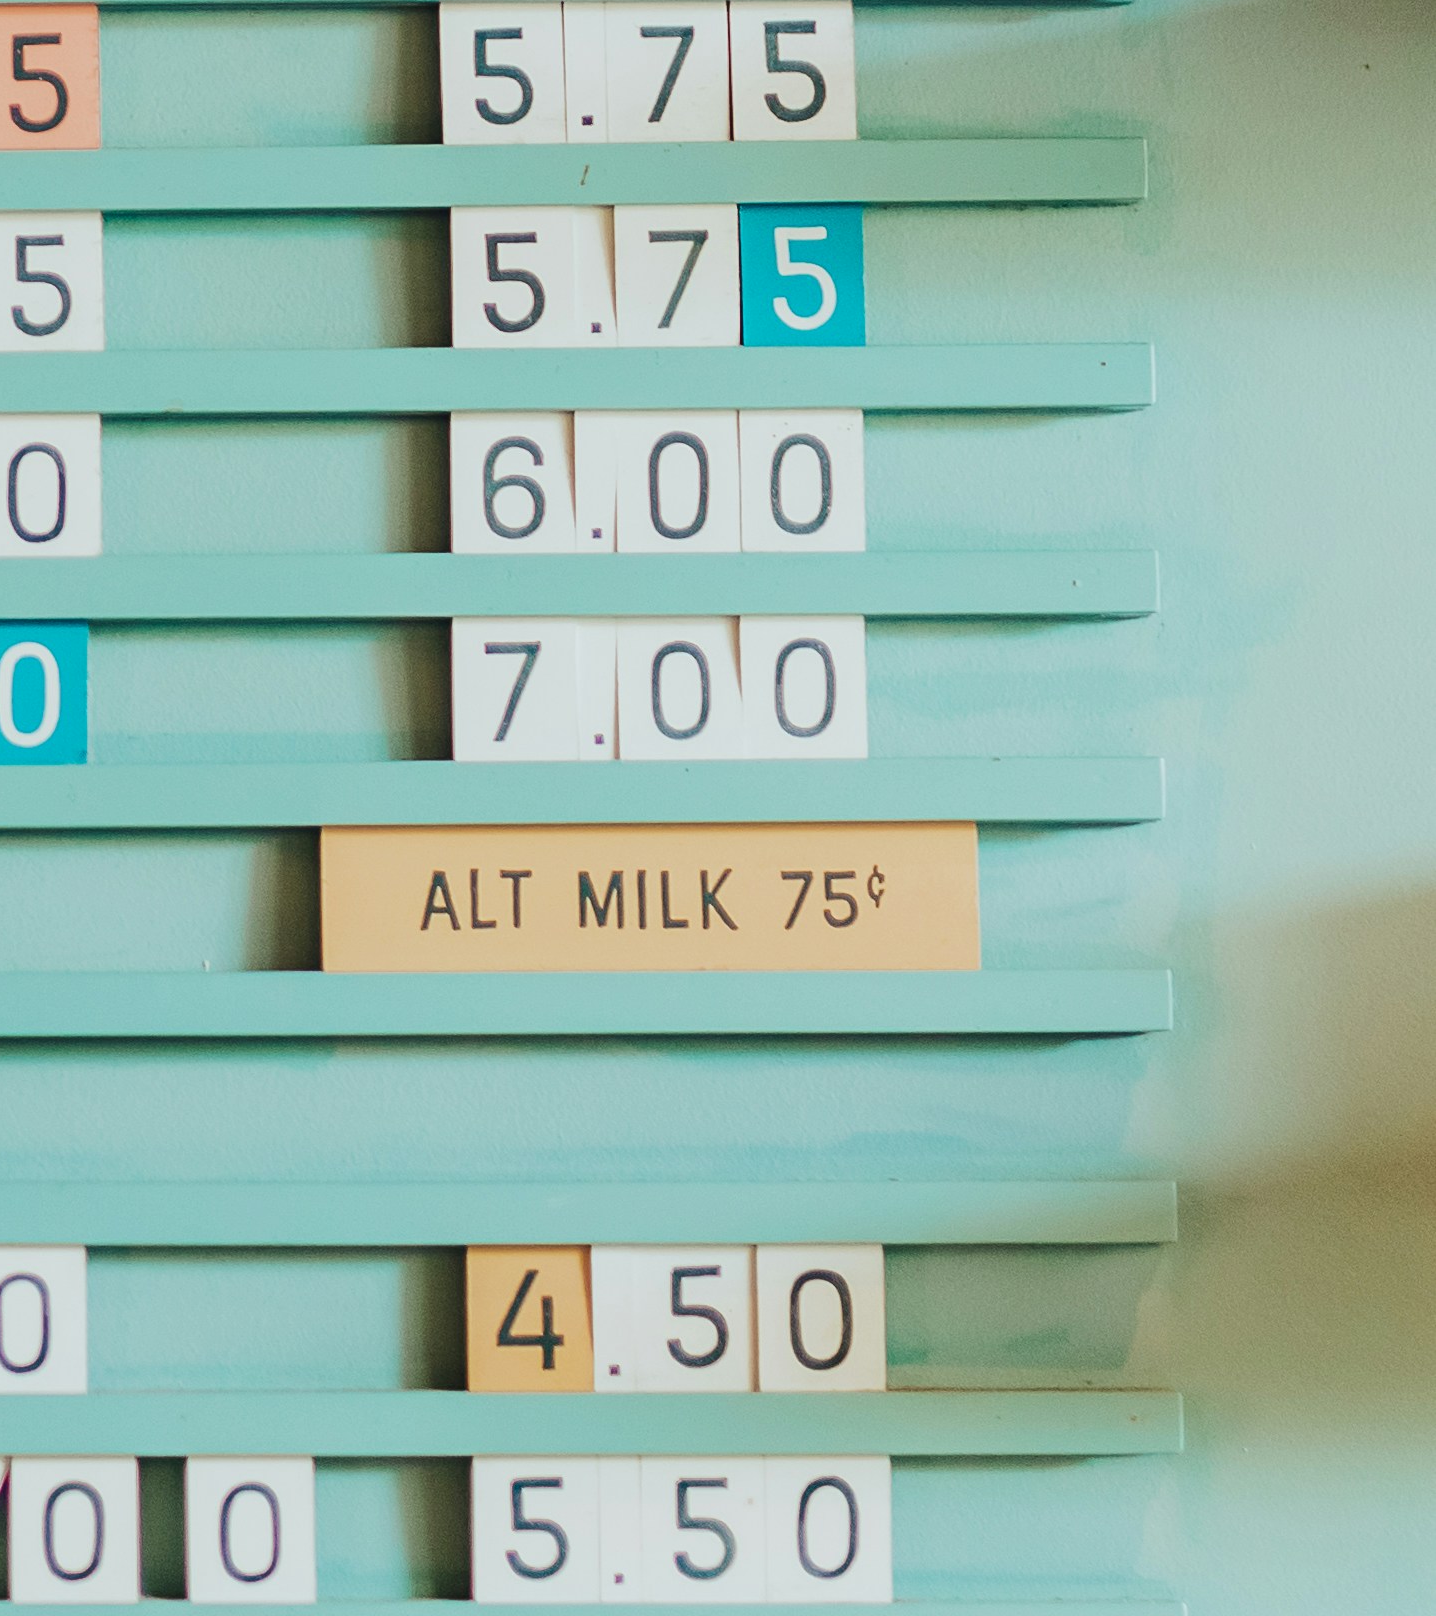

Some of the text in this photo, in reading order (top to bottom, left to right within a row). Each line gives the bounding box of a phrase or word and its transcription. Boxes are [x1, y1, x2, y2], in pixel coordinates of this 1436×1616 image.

[472, 20, 827, 126] 5.75
[482, 226, 836, 334] 5.75
[481, 430, 831, 540] 6.00
[482, 636, 837, 746] 7.00
[420, 869, 532, 930] ALT
[578, 869, 739, 930] MILK
[495, 1267, 853, 1377] 4.50
[502, 1476, 861, 1584] 5.50
